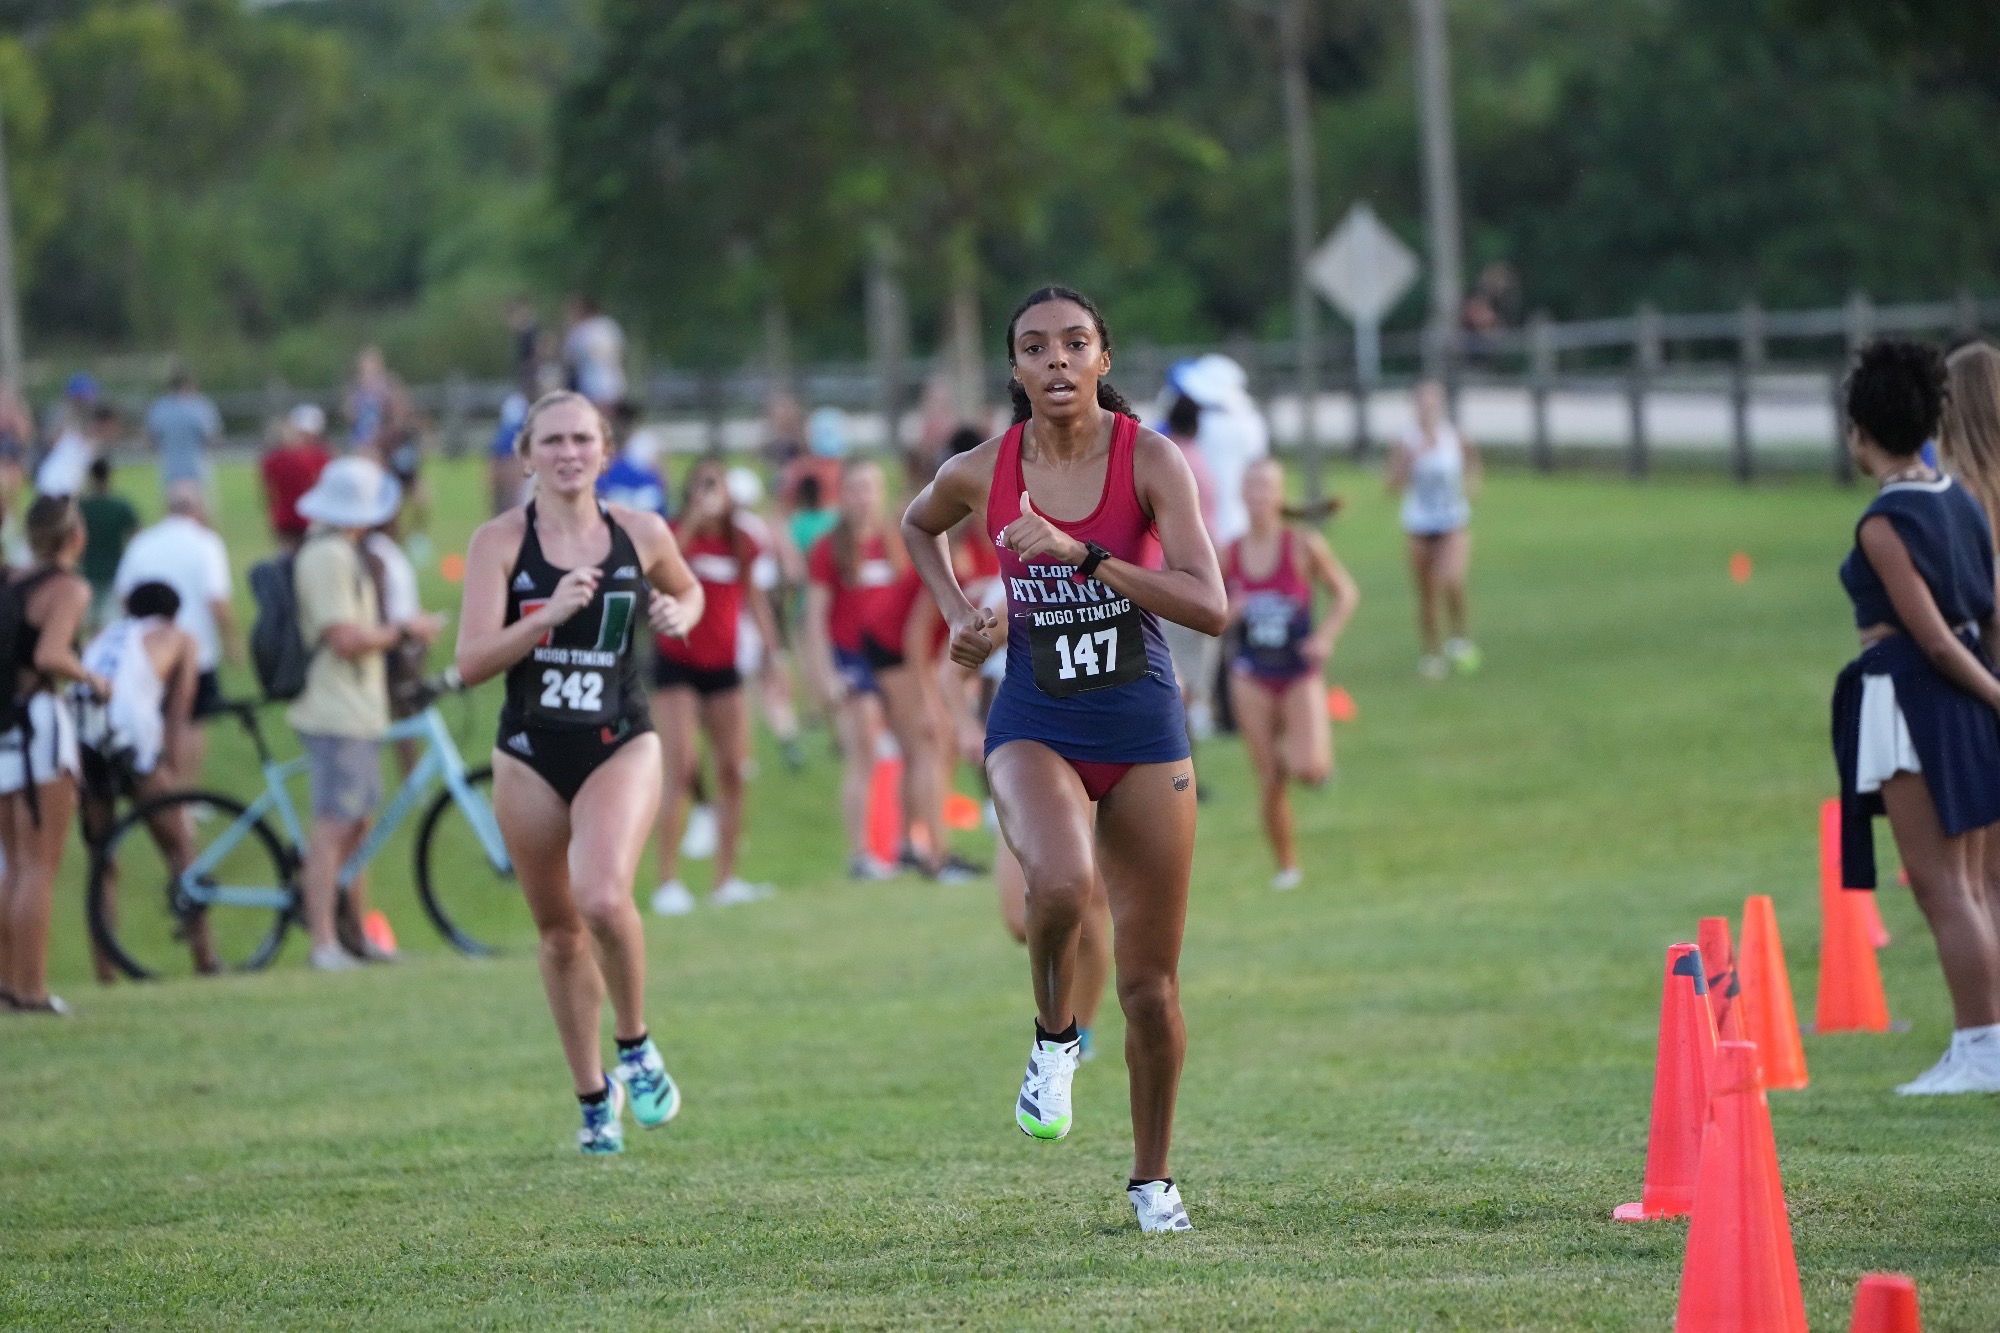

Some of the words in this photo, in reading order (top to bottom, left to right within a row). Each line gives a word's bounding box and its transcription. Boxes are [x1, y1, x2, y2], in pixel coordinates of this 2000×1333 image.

[1028, 565, 1078, 578] FLOR
[1010, 576, 1116, 604] ATLANT
[1033, 609, 1074, 627] MOGO
[1077, 598, 1131, 623] TIMING
[570, 649, 616, 668] TIMING
[1055, 626, 1118, 680] 147
[540, 668, 604, 711] 242
